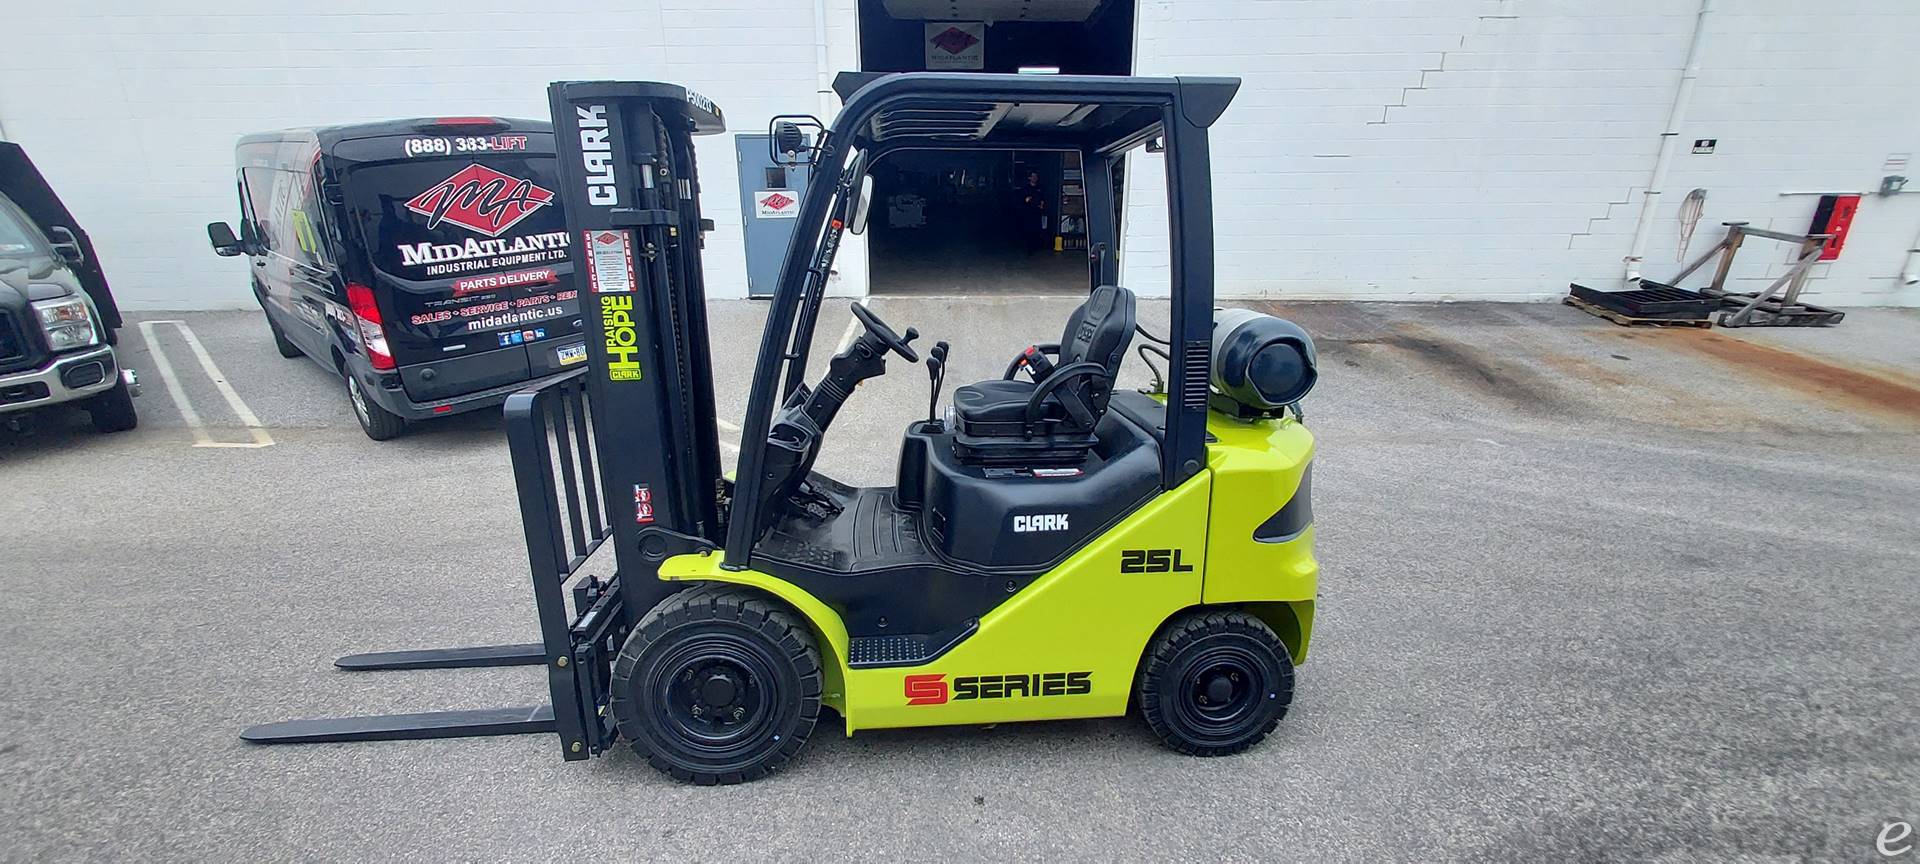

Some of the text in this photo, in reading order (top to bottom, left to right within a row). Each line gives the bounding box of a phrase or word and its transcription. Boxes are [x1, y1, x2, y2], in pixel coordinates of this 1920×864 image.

[405, 136, 527, 157] (888) 383-LIFT
[576, 105, 618, 206] CLARK
[427, 250, 567, 276] INDUSTRIAL EQUIPMENT LTD.
[585, 232, 599, 289] SERVICE
[622, 232, 637, 288] RENTALS
[460, 271, 550, 291] PARTS DELIVERY
[411, 311, 452, 325] SALES
[460, 301, 509, 316] SERVICE
[516, 295, 550, 308] PARTS
[467, 305, 563, 331] midatlantic.us
[601, 296, 617, 346] RAISING
[607, 295, 640, 369] HOPE
[611, 369, 640, 380] CLARK
[1014, 513, 1069, 532] CLARK
[1121, 548, 1193, 574] 25L
[952, 671, 1093, 700] SERIES
